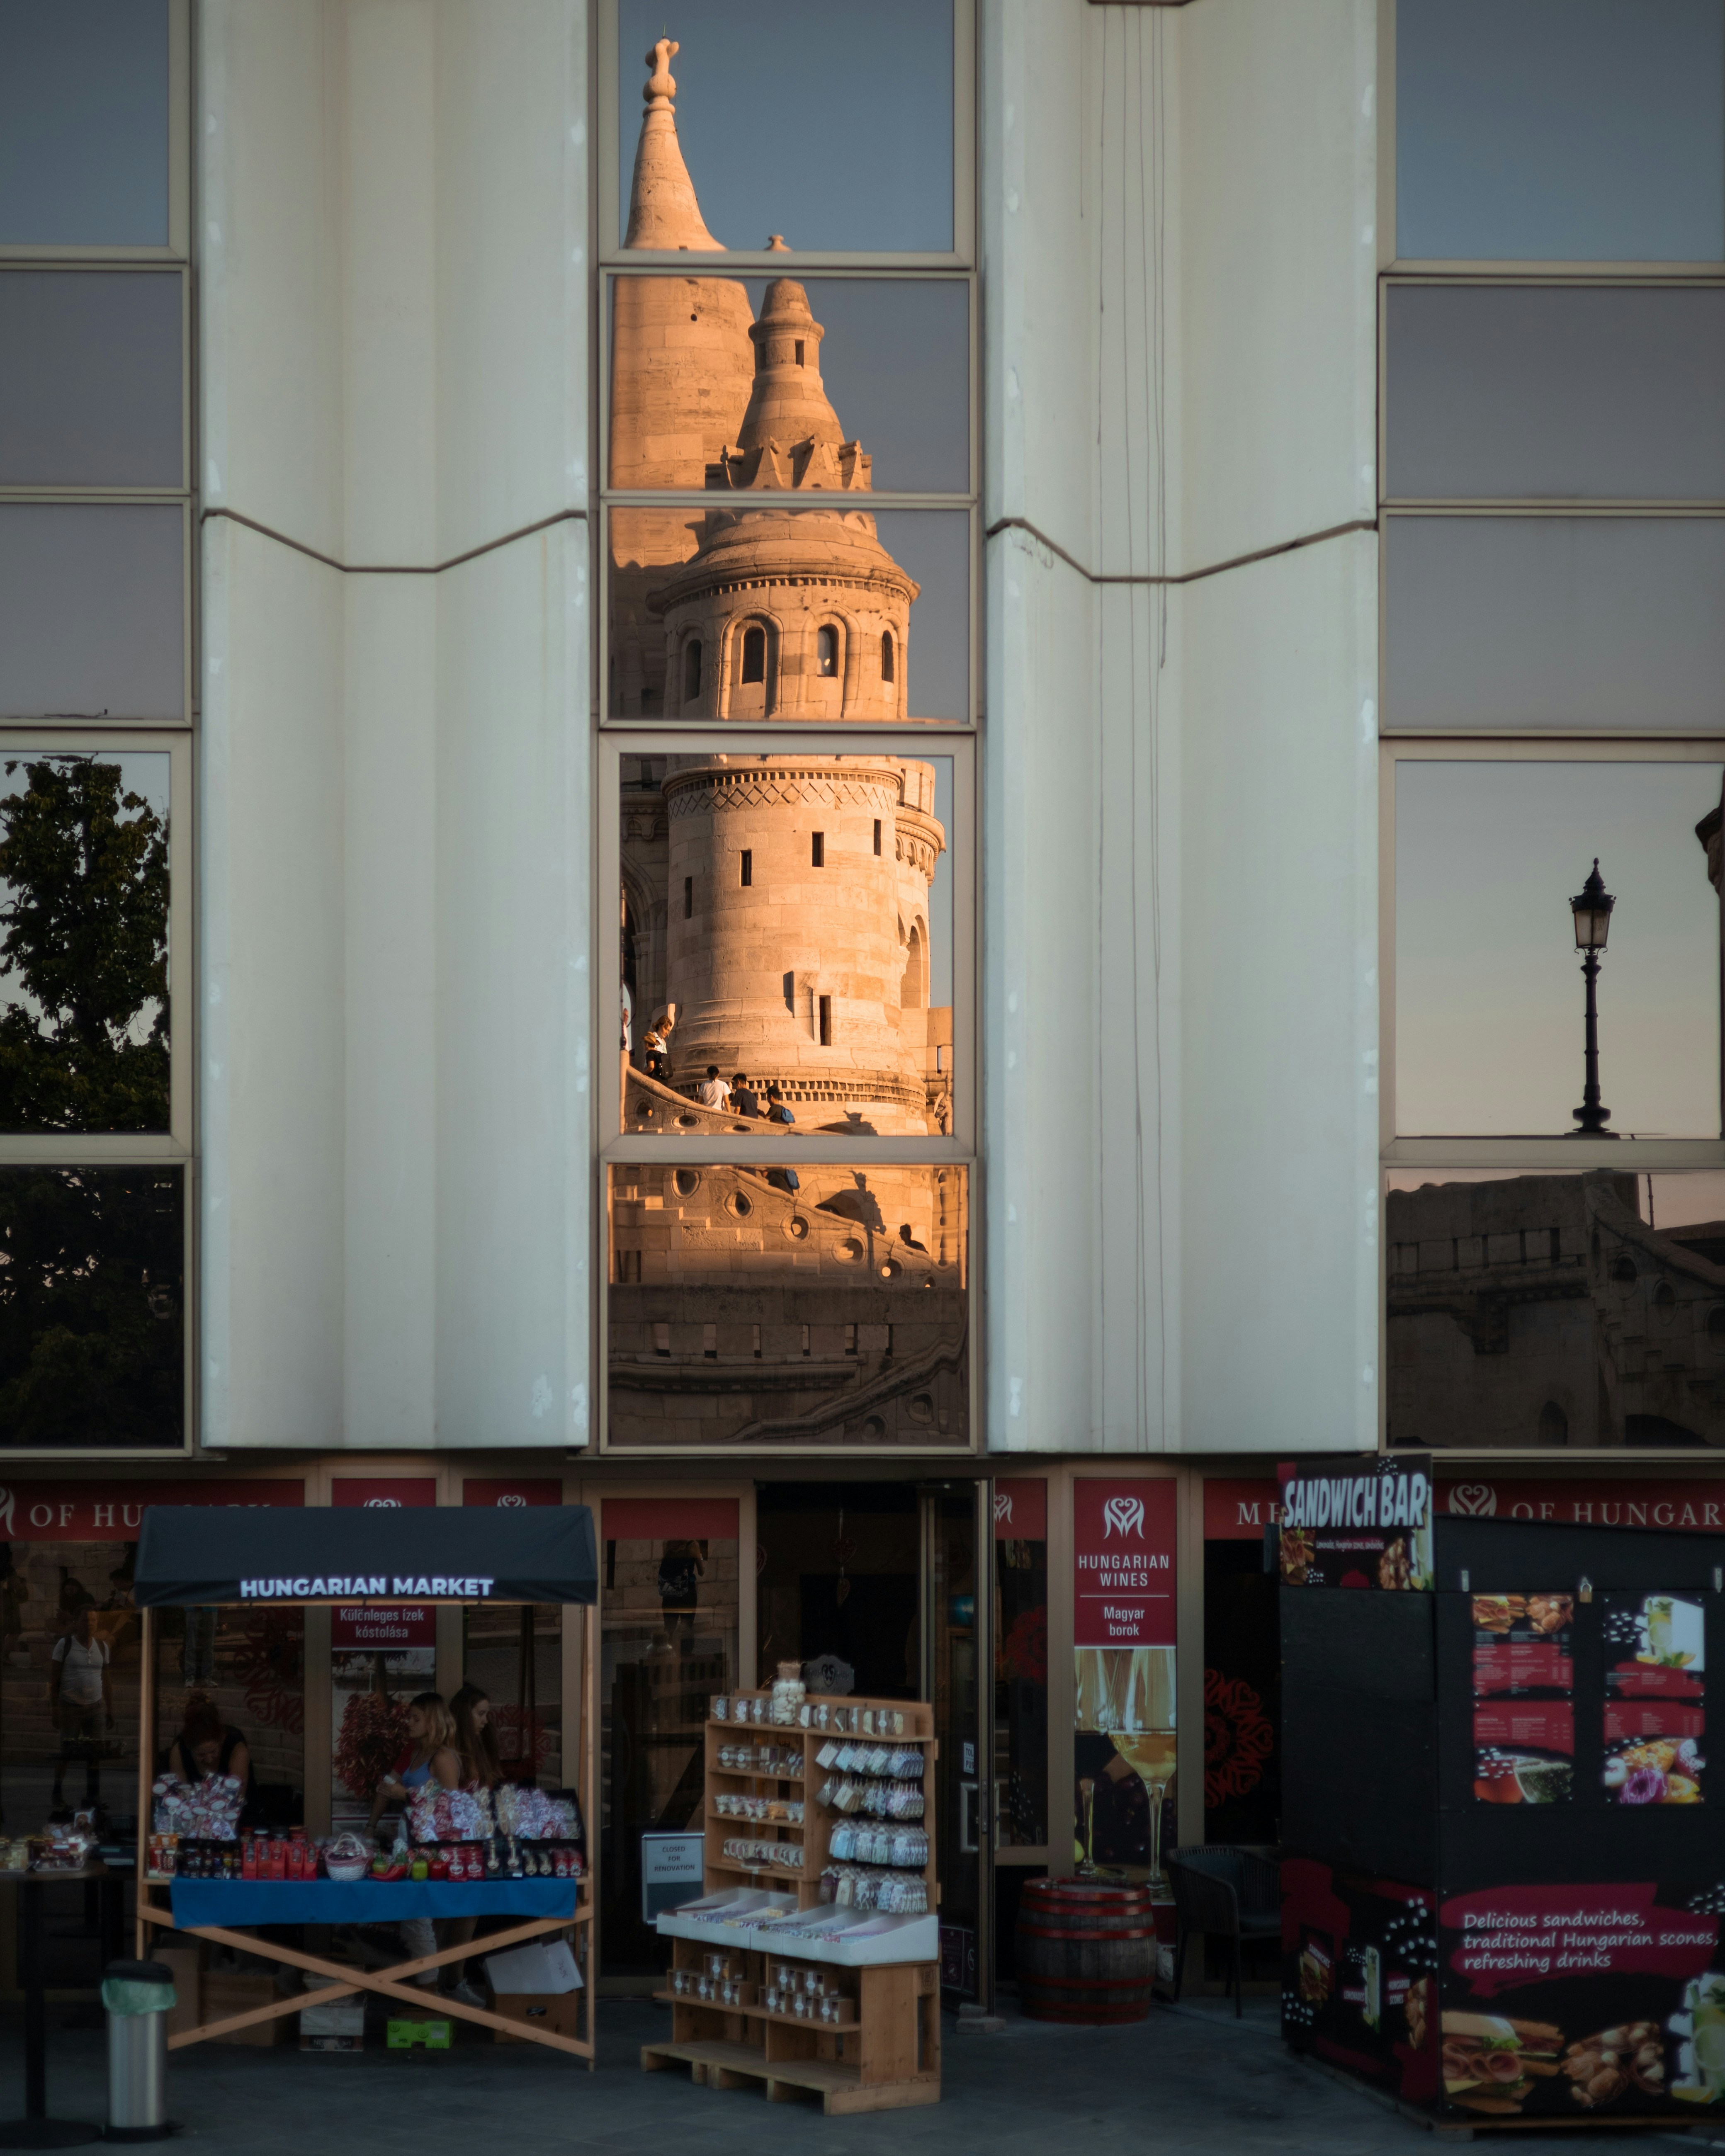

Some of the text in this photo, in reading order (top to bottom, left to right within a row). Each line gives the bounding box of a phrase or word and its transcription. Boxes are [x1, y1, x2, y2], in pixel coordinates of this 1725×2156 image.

[1284, 1477, 1377, 1528] SANDWICH
[1380, 1472, 1428, 1527] BAR
[30, 1505, 75, 1527] OF
[1511, 1503, 1725, 1526] OF HUNGAR
[1079, 1555, 1169, 1569] HUNGARIAN
[1100, 1572, 1148, 1586] WINES
[240, 1578, 494, 1598] HUNGARIAN MARKET
[403, 1608, 424, 1621] ízek
[1104, 1606, 1145, 1622] Magyar
[355, 1625, 409, 1638] kóstolása
[1109, 1623, 1139, 1636] borok
[1465, 1910, 1646, 1929] Delicious sandwiches,
[1465, 1930, 1720, 1951] traditional Hungarian scones,
[1465, 1952, 1612, 1974] refreshing drinks
[1390, 1993, 1404, 2005] SCONES
